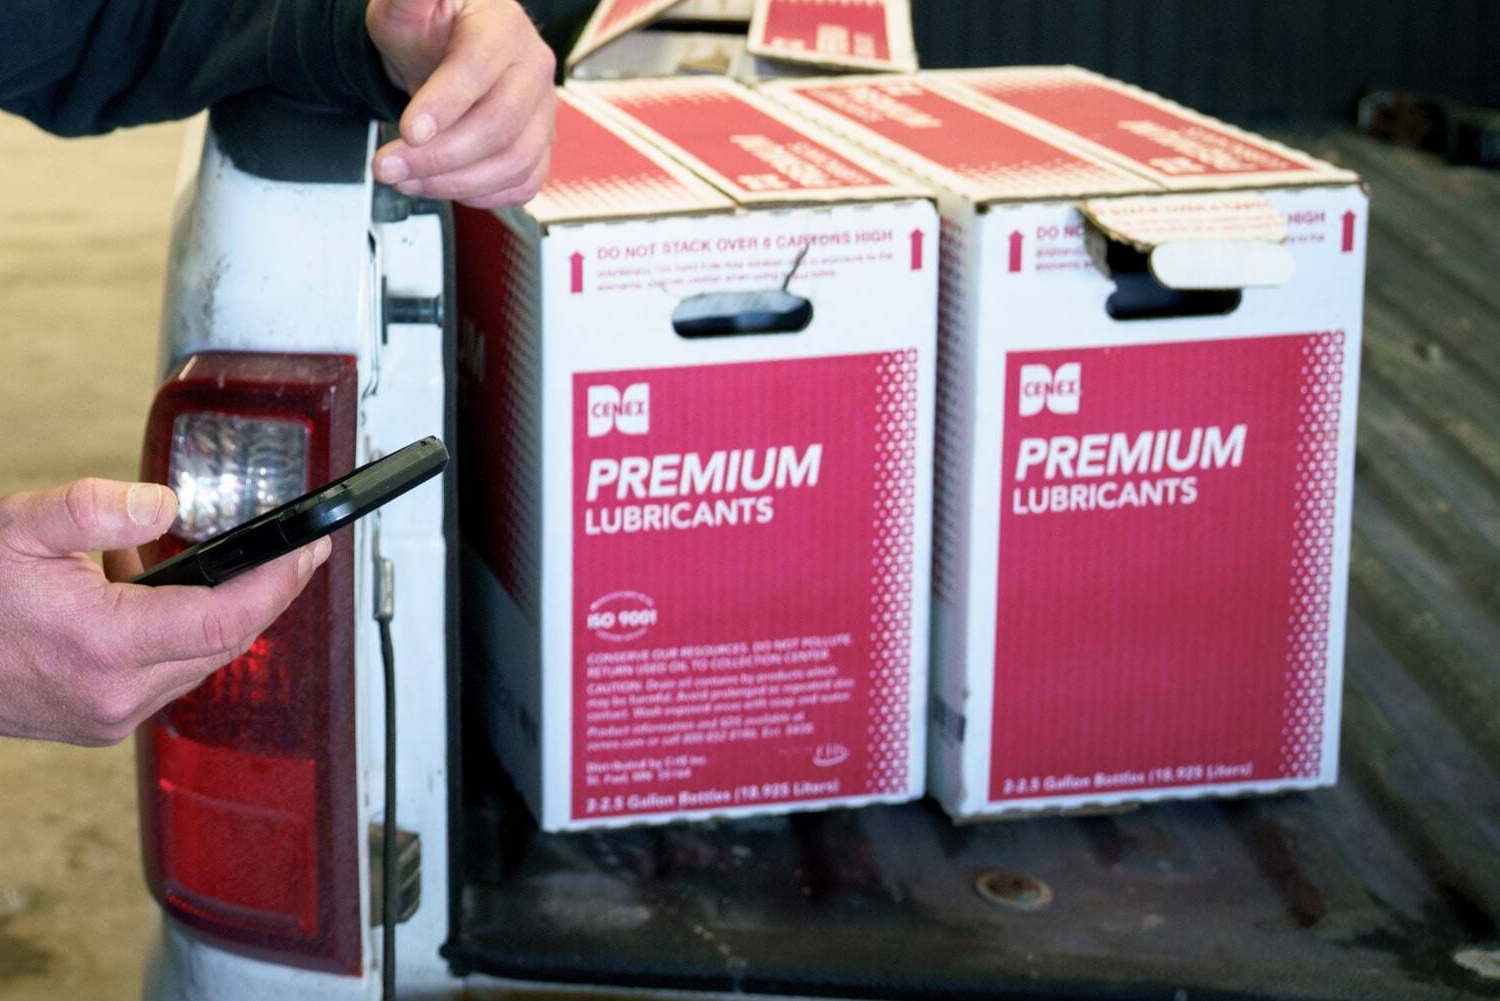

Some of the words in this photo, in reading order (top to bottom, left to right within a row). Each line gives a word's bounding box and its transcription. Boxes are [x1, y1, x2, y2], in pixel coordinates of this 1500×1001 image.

[597, 246, 620, 260] DO
[625, 243, 656, 258] NOT
[662, 240, 711, 254] STACK
[716, 236, 758, 252] OVER
[776, 231, 851, 248] CARTONS
[855, 229, 893, 243] HIGH
[1036, 226, 1059, 240] DO
[1287, 211, 1327, 225] HIGH
[1015, 424, 1247, 481] PREMIUM
[586, 443, 823, 502] PREMIUM
[1013, 477, 1198, 514] LUBRICANTS
[584, 496, 774, 535] LUBRICANTS
